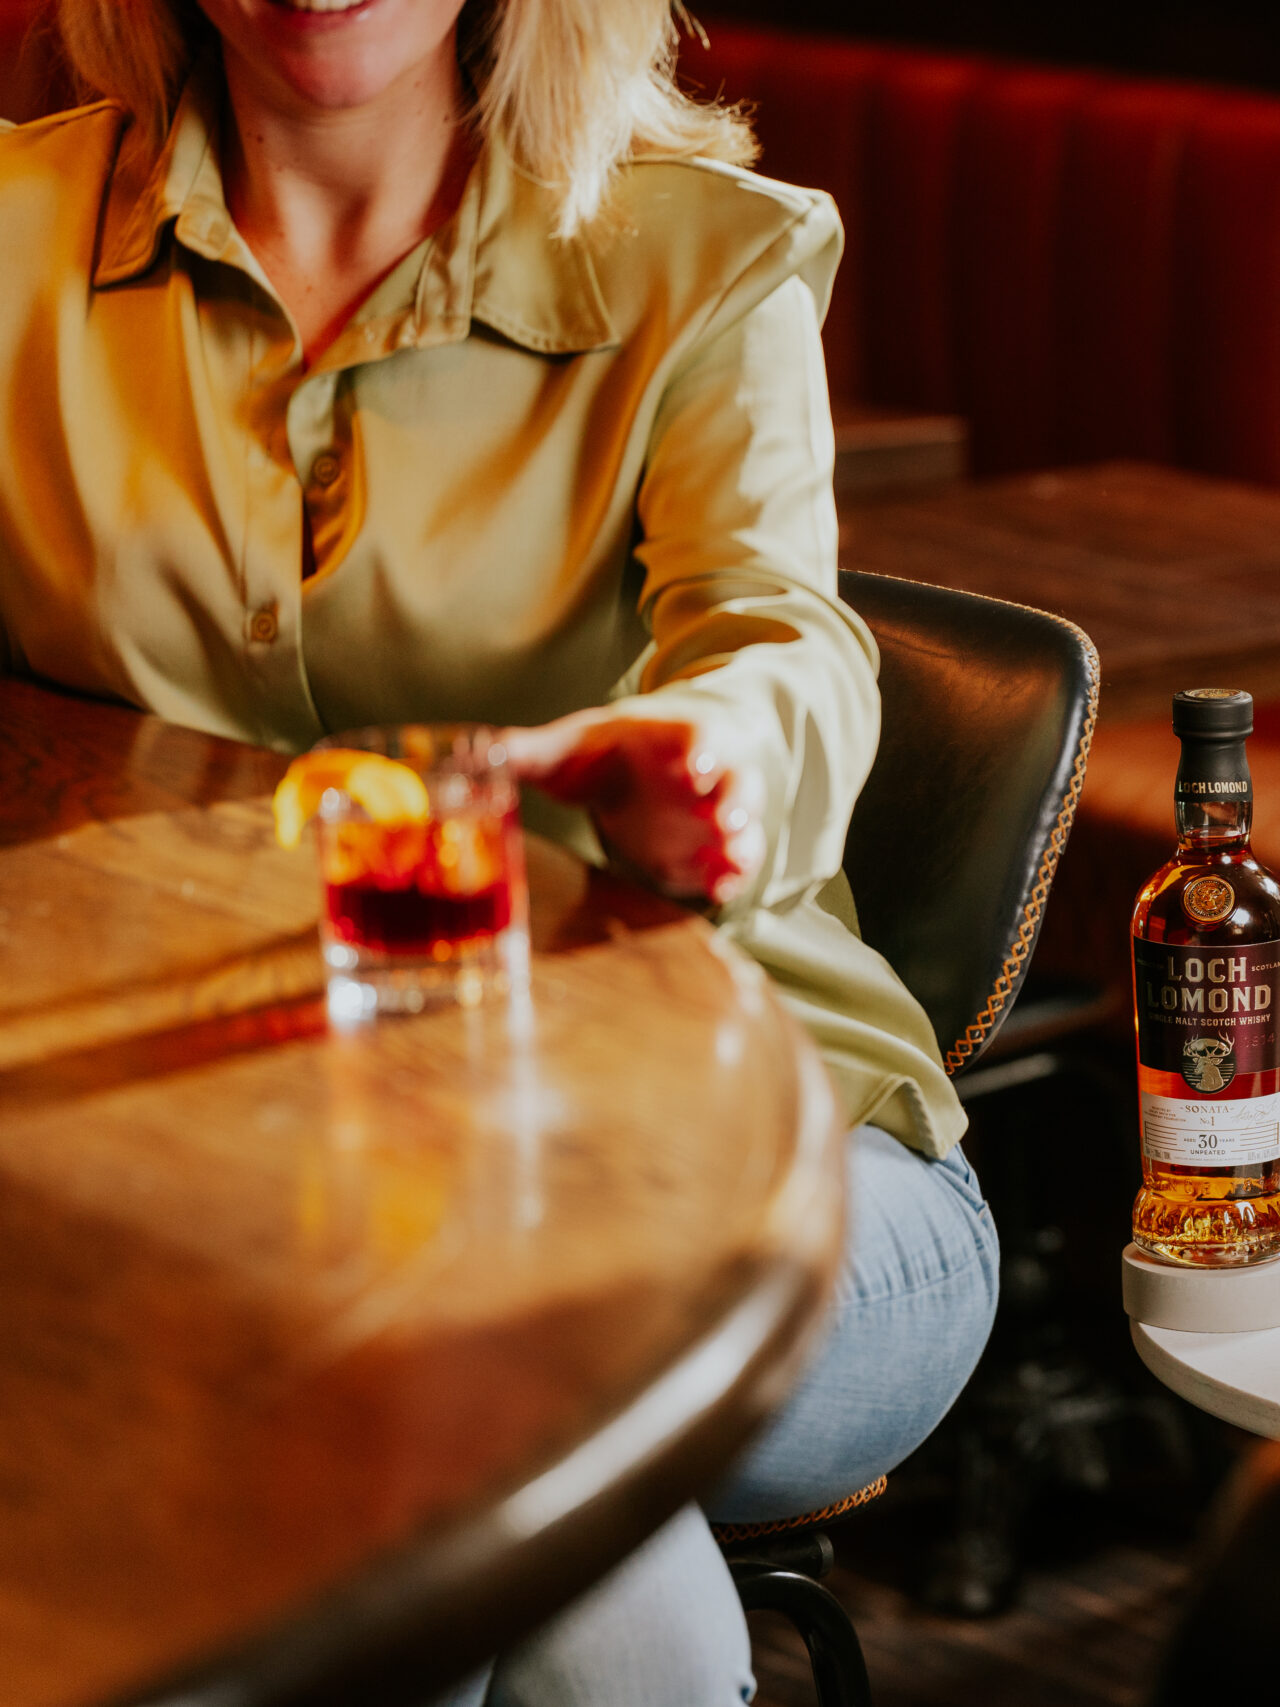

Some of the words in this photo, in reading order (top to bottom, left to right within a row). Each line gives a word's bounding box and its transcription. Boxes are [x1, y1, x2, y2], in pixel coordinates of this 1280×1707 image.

[1178, 780, 1206, 794] LOCH
[1208, 780, 1248, 794] LOMOND
[1168, 956, 1248, 983] LOCH
[1146, 981, 1272, 1013] LOMOND
[1176, 1016, 1197, 1026] MALT
[1200, 1018, 1236, 1026] SCOTCH
[1239, 1014, 1272, 1026] WHISKY
[1198, 1134, 1218, 1149] 30
